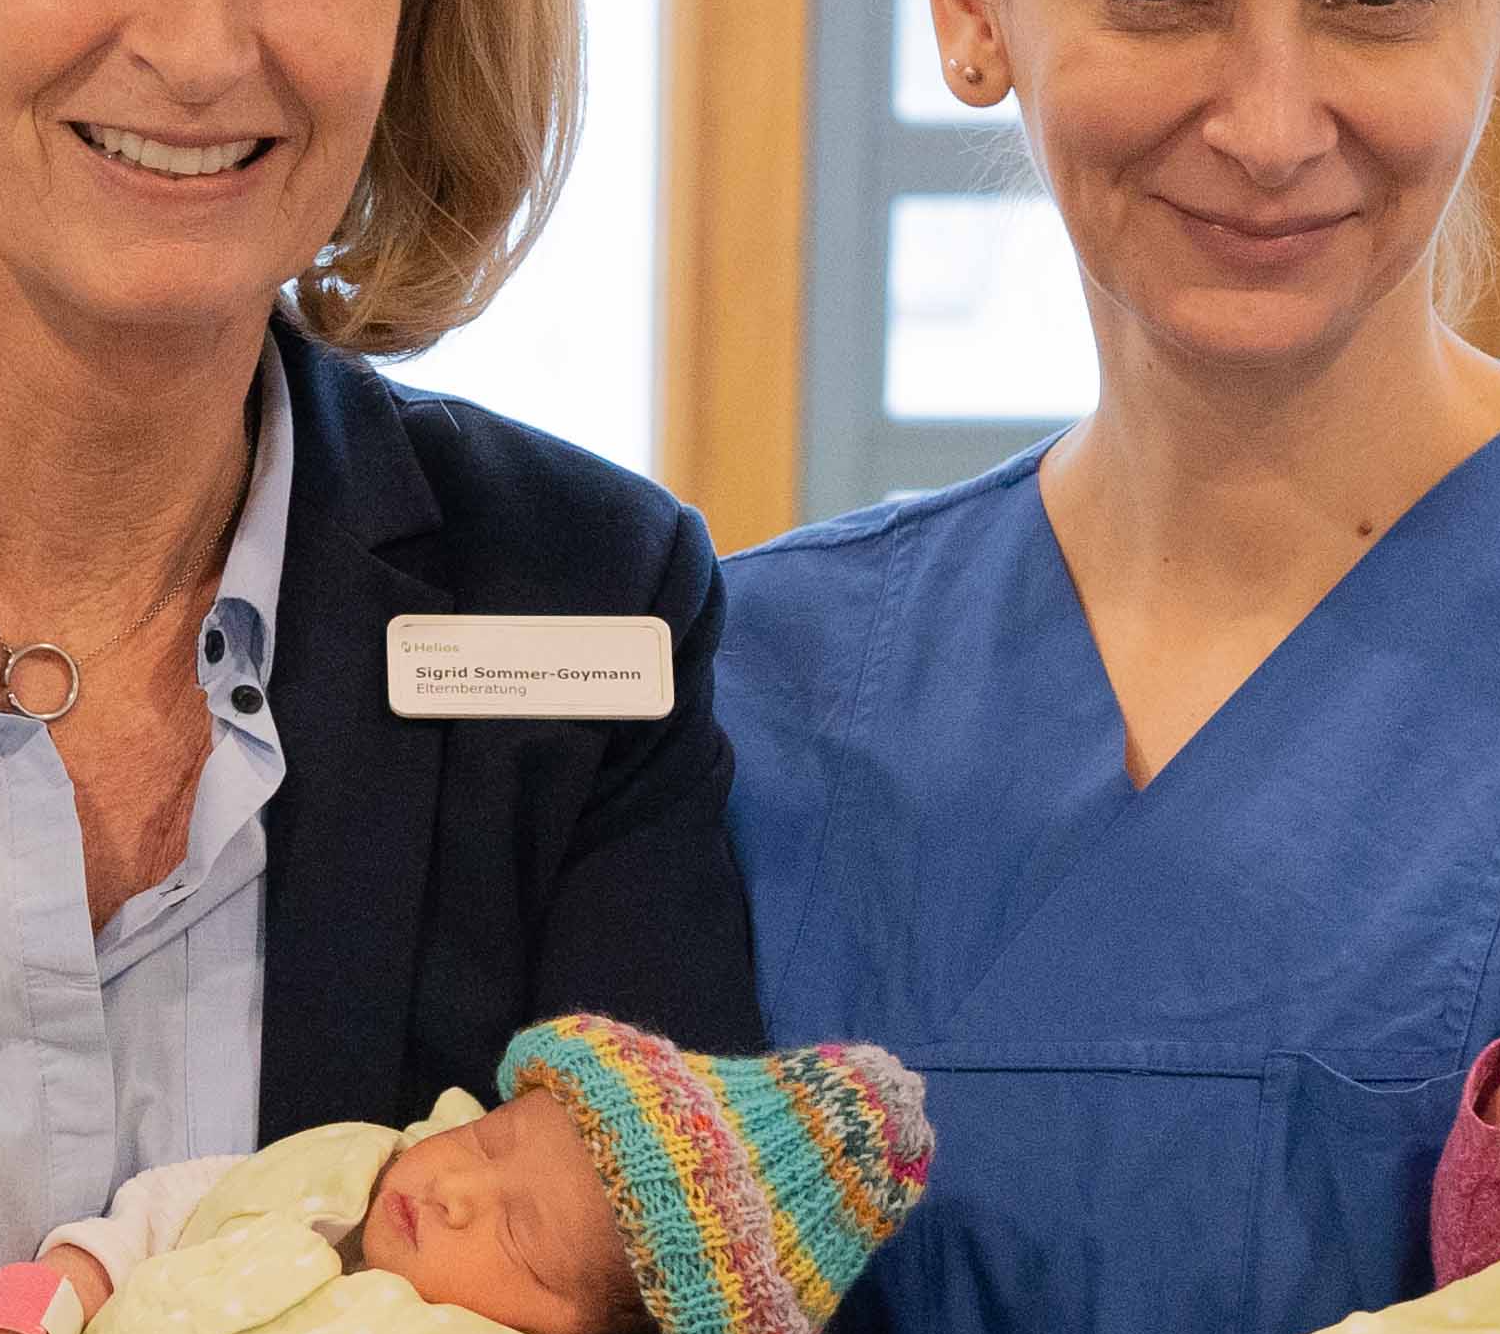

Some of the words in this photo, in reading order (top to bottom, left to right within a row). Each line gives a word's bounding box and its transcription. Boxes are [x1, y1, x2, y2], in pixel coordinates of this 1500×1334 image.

[413, 642, 460, 653] Helios
[415, 666, 469, 681] Sigrid
[474, 666, 642, 683] Sommer-Goymann
[416, 682, 528, 698] Elternberatung
